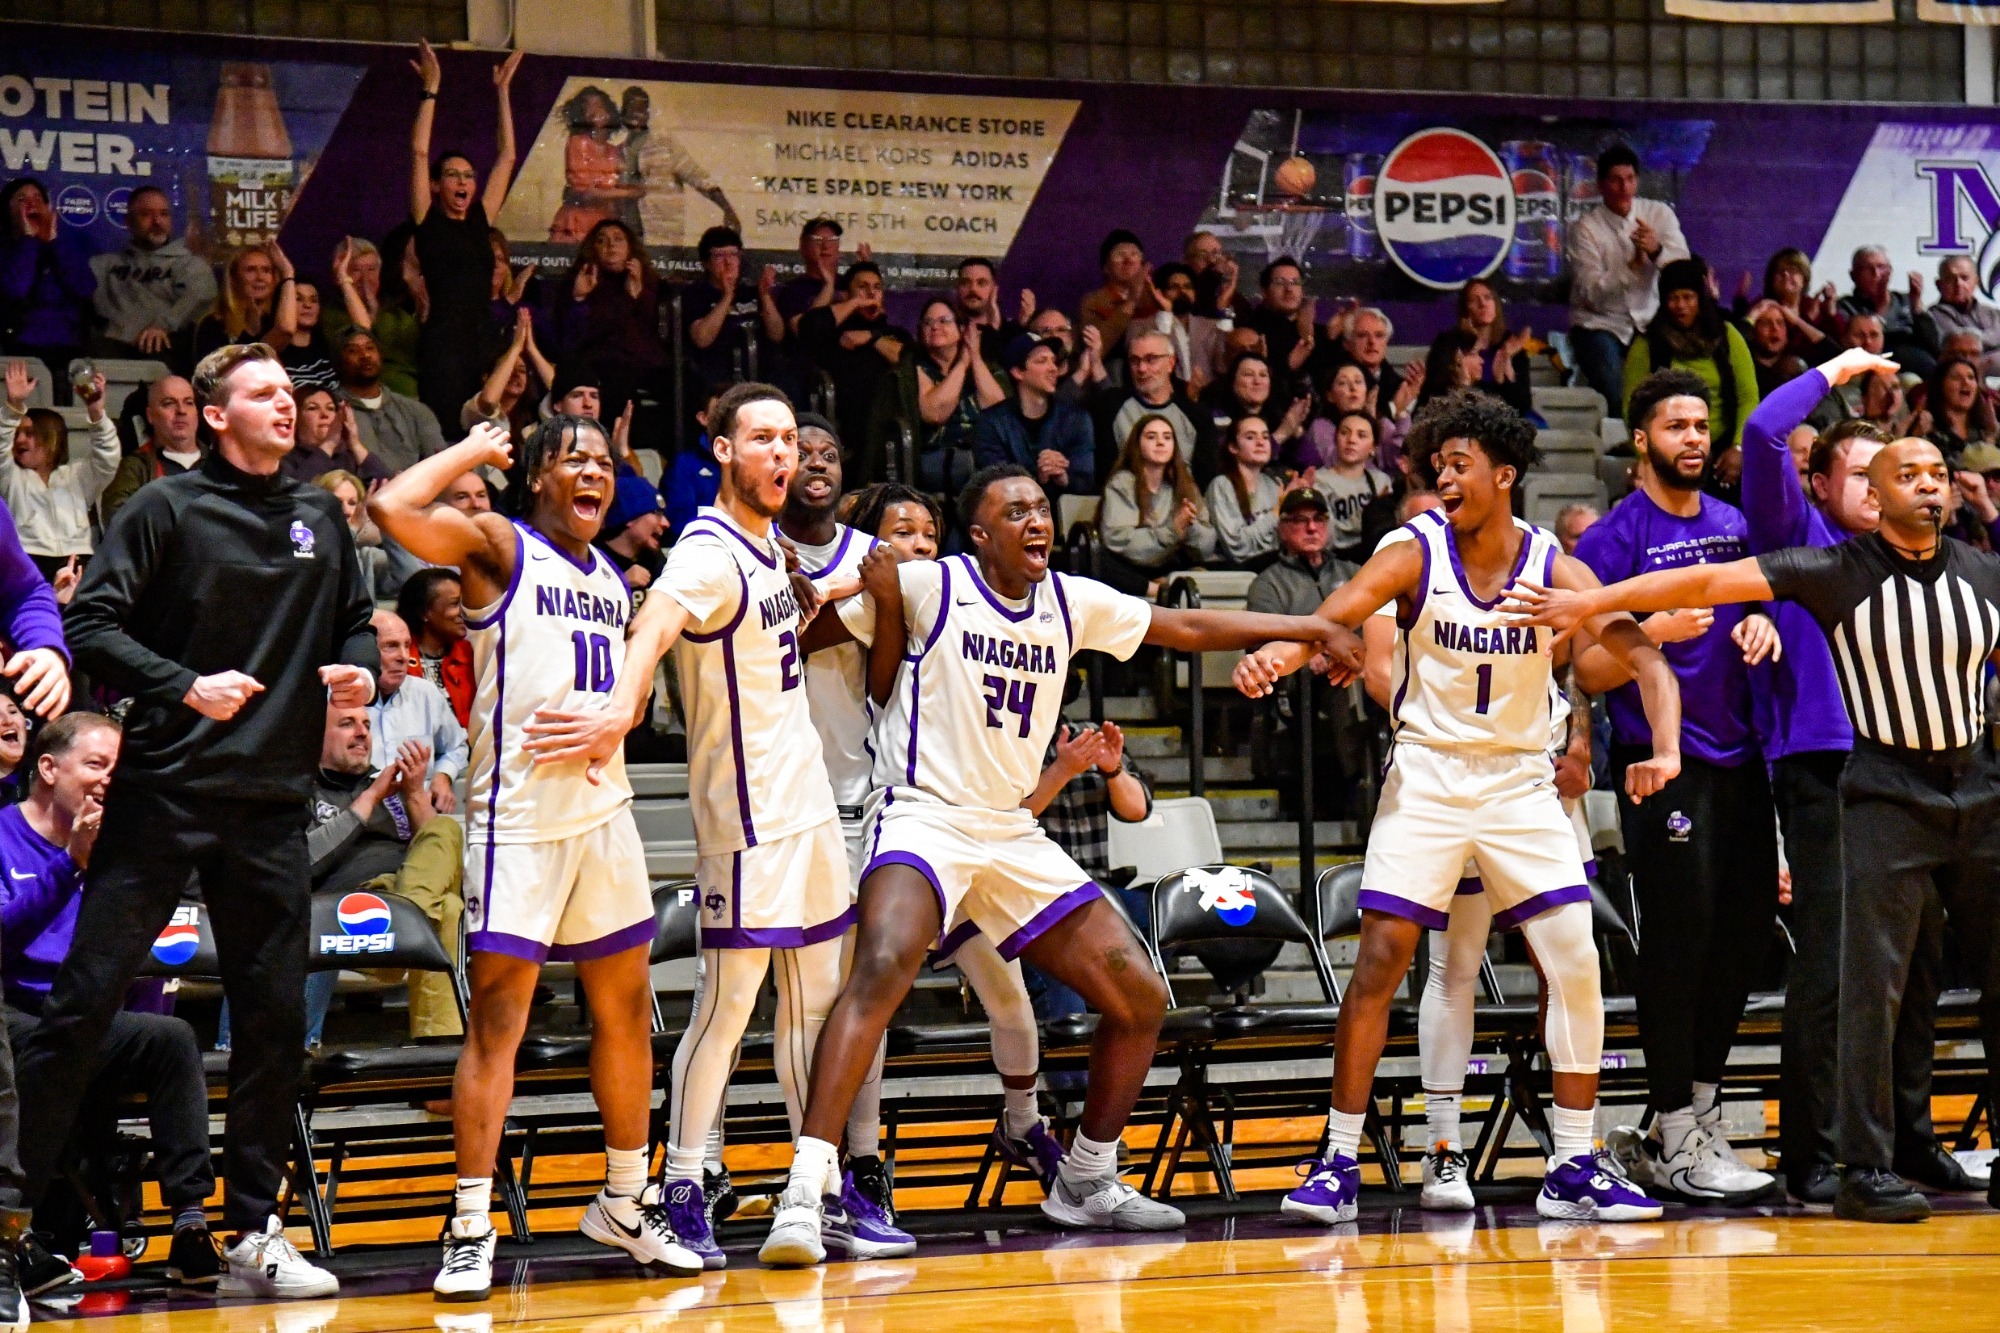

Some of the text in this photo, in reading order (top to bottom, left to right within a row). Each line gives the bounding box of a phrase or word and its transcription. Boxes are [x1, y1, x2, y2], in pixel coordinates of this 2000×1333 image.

[786, 110, 1045, 137] NIKE CLEARANCE STORE
[775, 143, 931, 165] MICHAEL KORS
[952, 150, 1029, 169] ADIDAS
[226, 190, 278, 209] MILK
[763, 176, 1013, 201] KATE SPADE NEW YORK
[233, 209, 280, 229] LIFE
[1384, 191, 1506, 225] PEPSI
[867, 213, 906, 230] 5TH
[925, 215, 998, 233] COACH
[1647, 539, 1699, 556] PURPLE
[536, 584, 624, 628] NIAGARA
[1433, 620, 1538, 654] NIAGARA
[571, 630, 615, 692] 10
[962, 630, 1056, 674] NIAGARA
[1475, 664, 1492, 715] 1
[983, 673, 1037, 738] 24
[320, 932, 396, 954] PEPSI
[1481, 1062, 1488, 1075] 2
